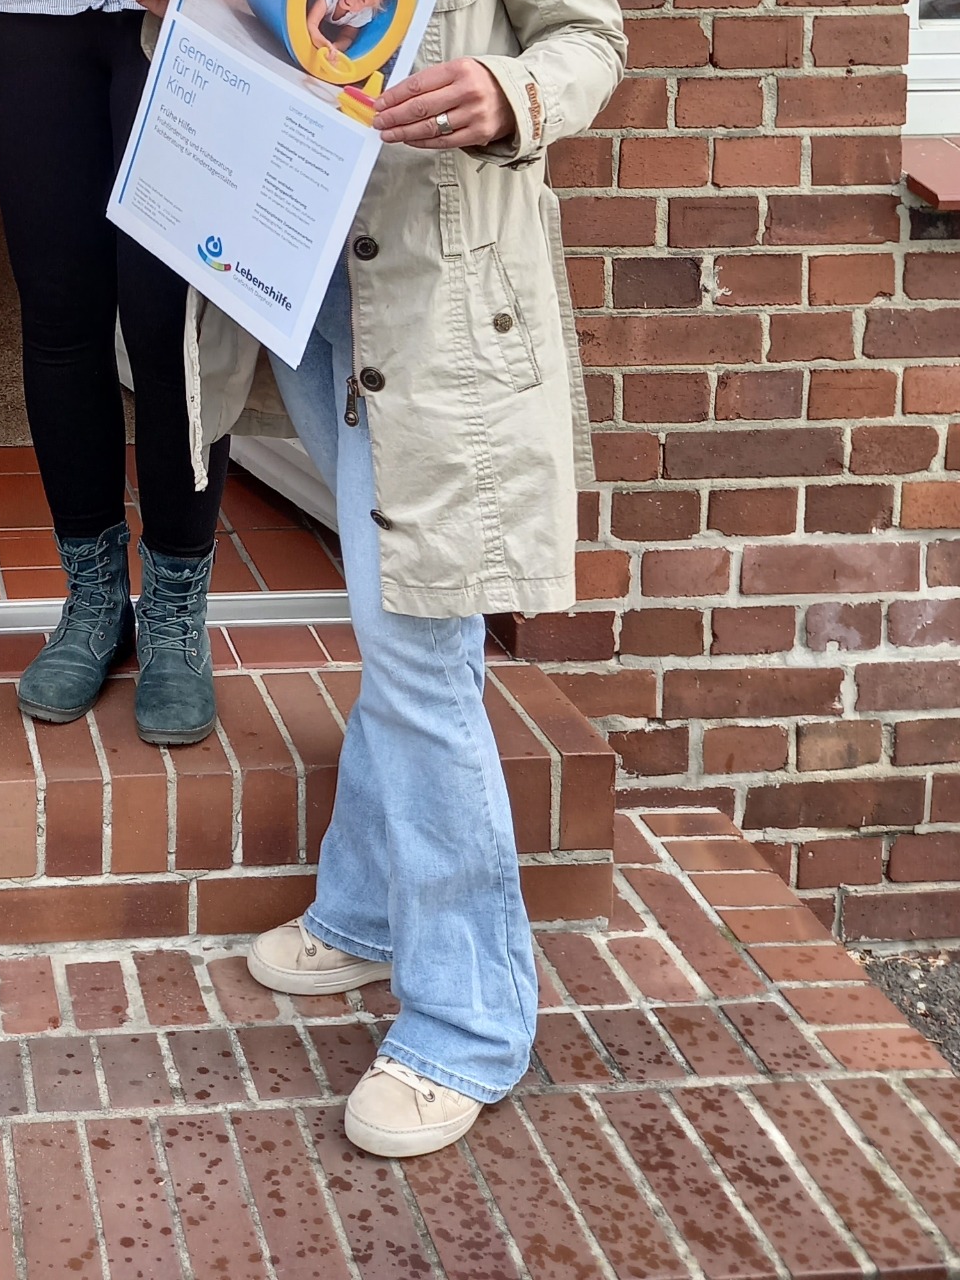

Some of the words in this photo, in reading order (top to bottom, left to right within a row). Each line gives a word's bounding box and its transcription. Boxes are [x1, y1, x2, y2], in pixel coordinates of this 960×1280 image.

[171, 55, 191, 76] für
[190, 69, 209, 91] Ihr
[178, 36, 251, 96] Gemeinsam
[166, 74, 197, 108] Kind!
[159, 103, 179, 123] Frühe
[177, 113, 197, 137] Hilfen
[235, 261, 293, 312] Lebenshilfe
